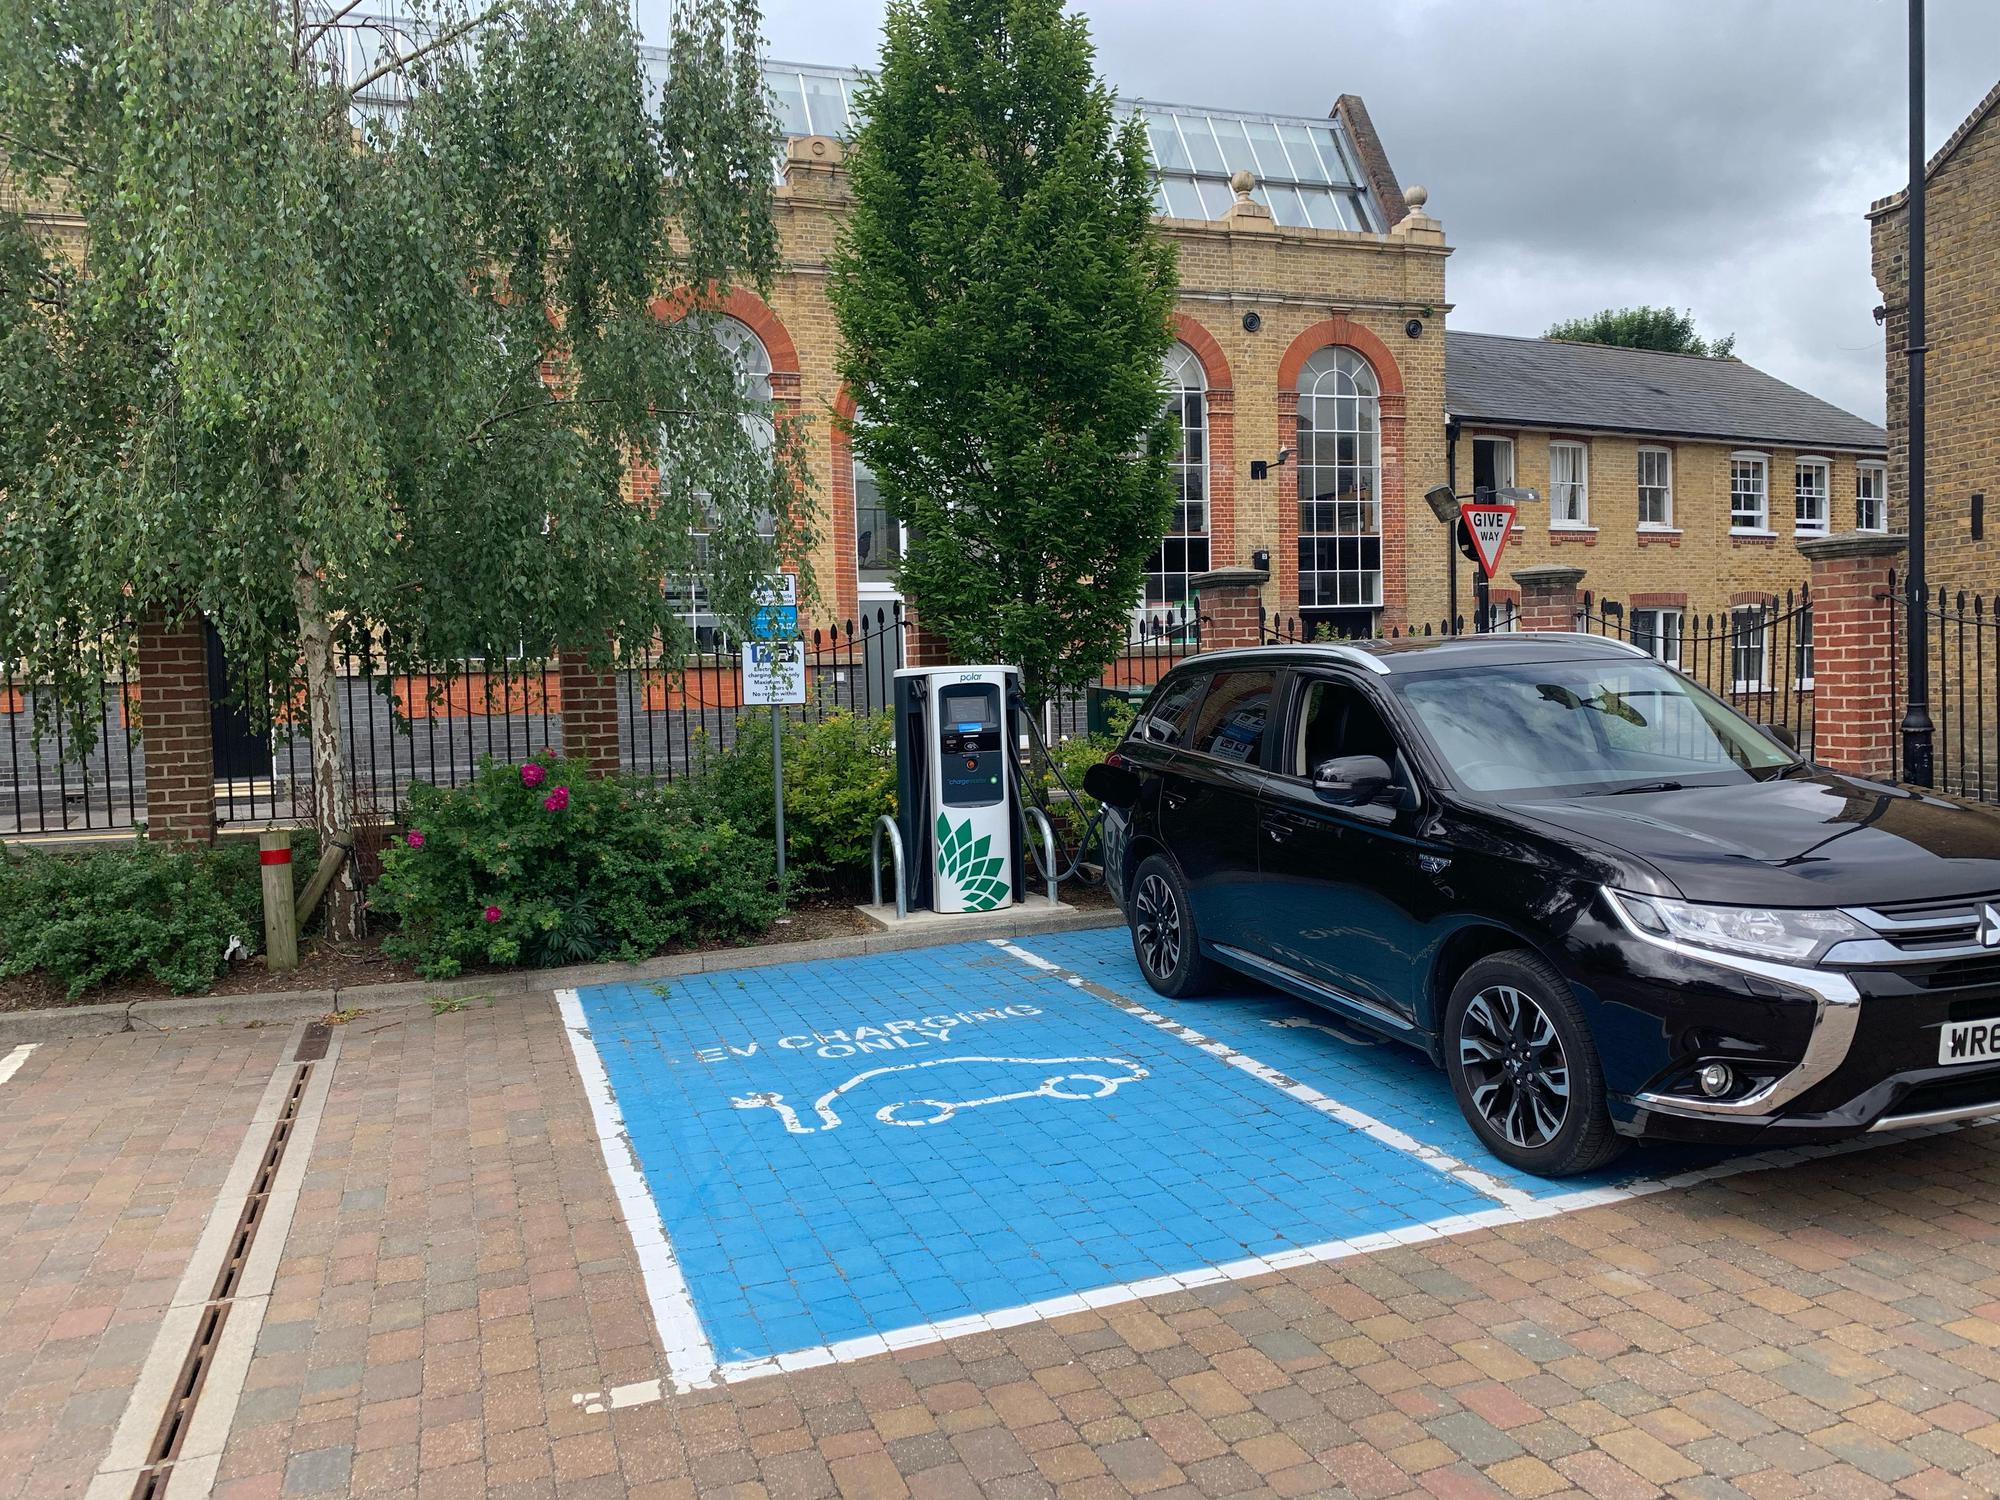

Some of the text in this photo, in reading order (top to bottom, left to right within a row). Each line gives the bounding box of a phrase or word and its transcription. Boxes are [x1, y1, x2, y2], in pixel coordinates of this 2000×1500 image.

[1474, 513, 1503, 527] GIVE
[1480, 531, 1499, 541] WAY
[748, 671, 772, 680] charging
[960, 672, 983, 682] polar
[692, 1004, 1043, 1063] EV CHARGING
[816, 1028, 952, 1058] ONLY
